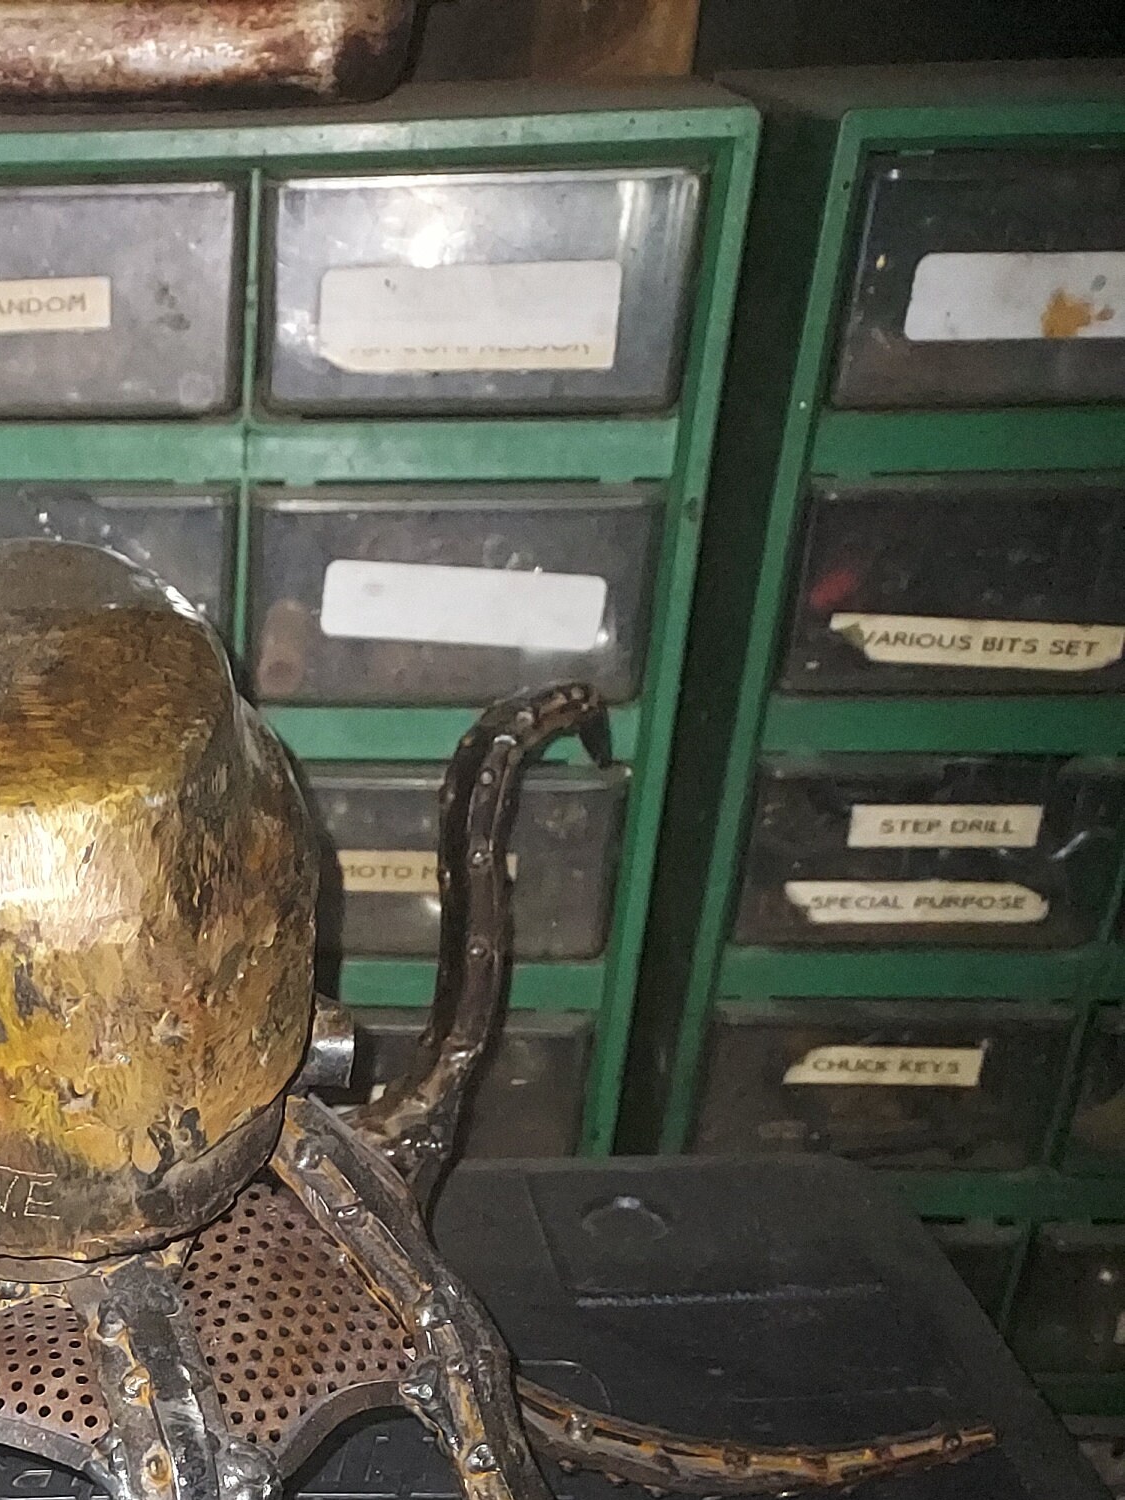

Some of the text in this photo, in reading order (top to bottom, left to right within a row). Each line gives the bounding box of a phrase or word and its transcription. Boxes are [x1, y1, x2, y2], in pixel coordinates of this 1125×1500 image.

[863, 630, 1100, 656] VARIOUS BITS SET
[880, 818, 1014, 834] STEP DRILL
[809, 895, 1025, 910] SPECIAL PURPOSE
[813, 1058, 959, 1074] CHUCK KEYS
